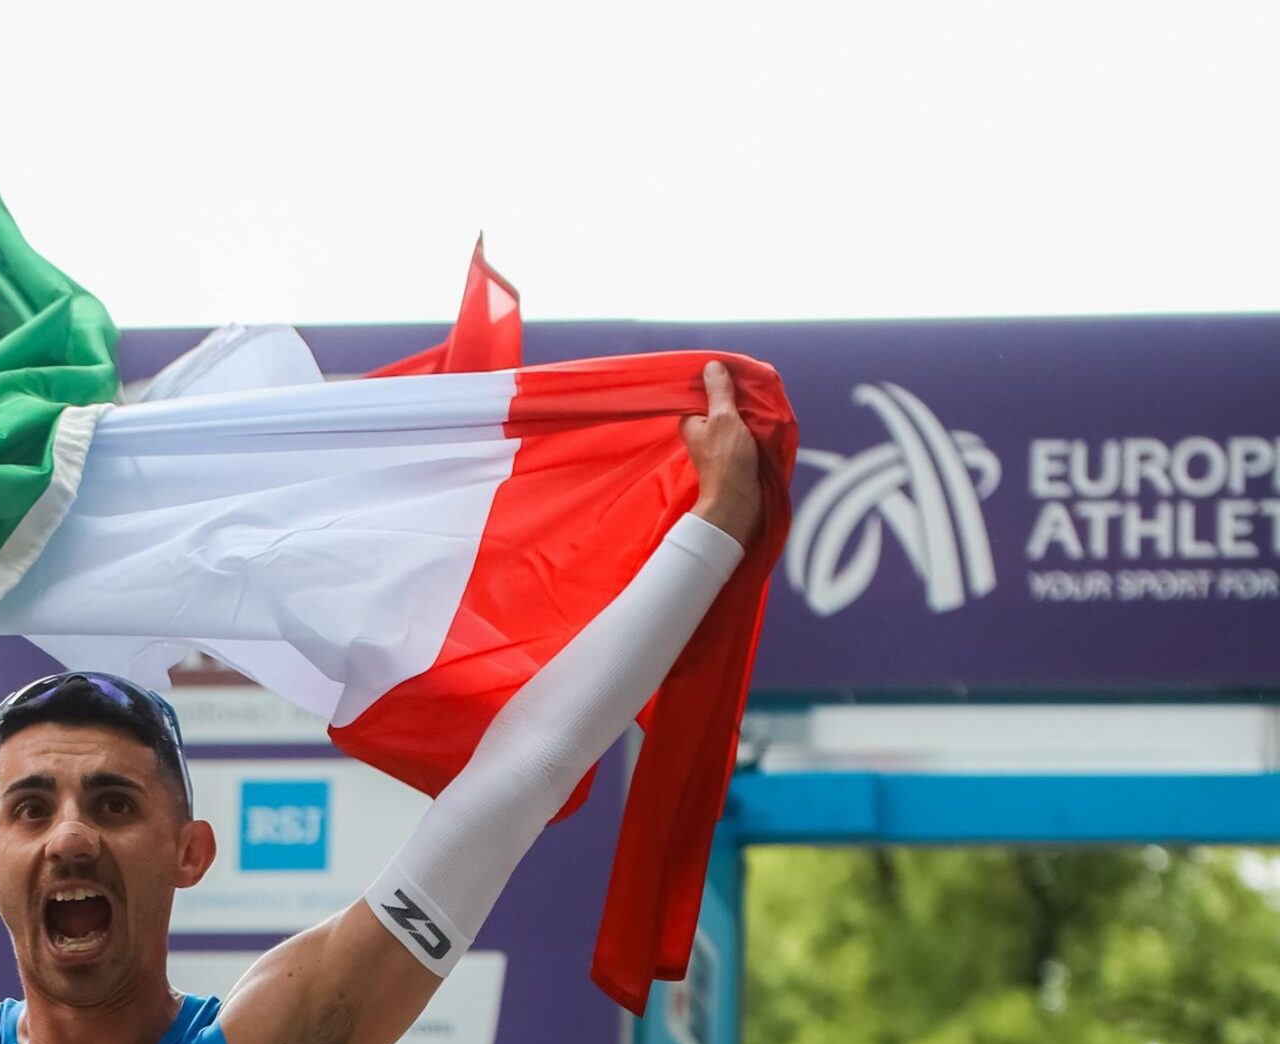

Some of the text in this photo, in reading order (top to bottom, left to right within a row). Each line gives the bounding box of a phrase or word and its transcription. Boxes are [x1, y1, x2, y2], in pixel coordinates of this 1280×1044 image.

[1030, 436, 1280, 498] EUROP
[1028, 569, 1114, 600] YOUR
[1117, 569, 1213, 600] SPORT
